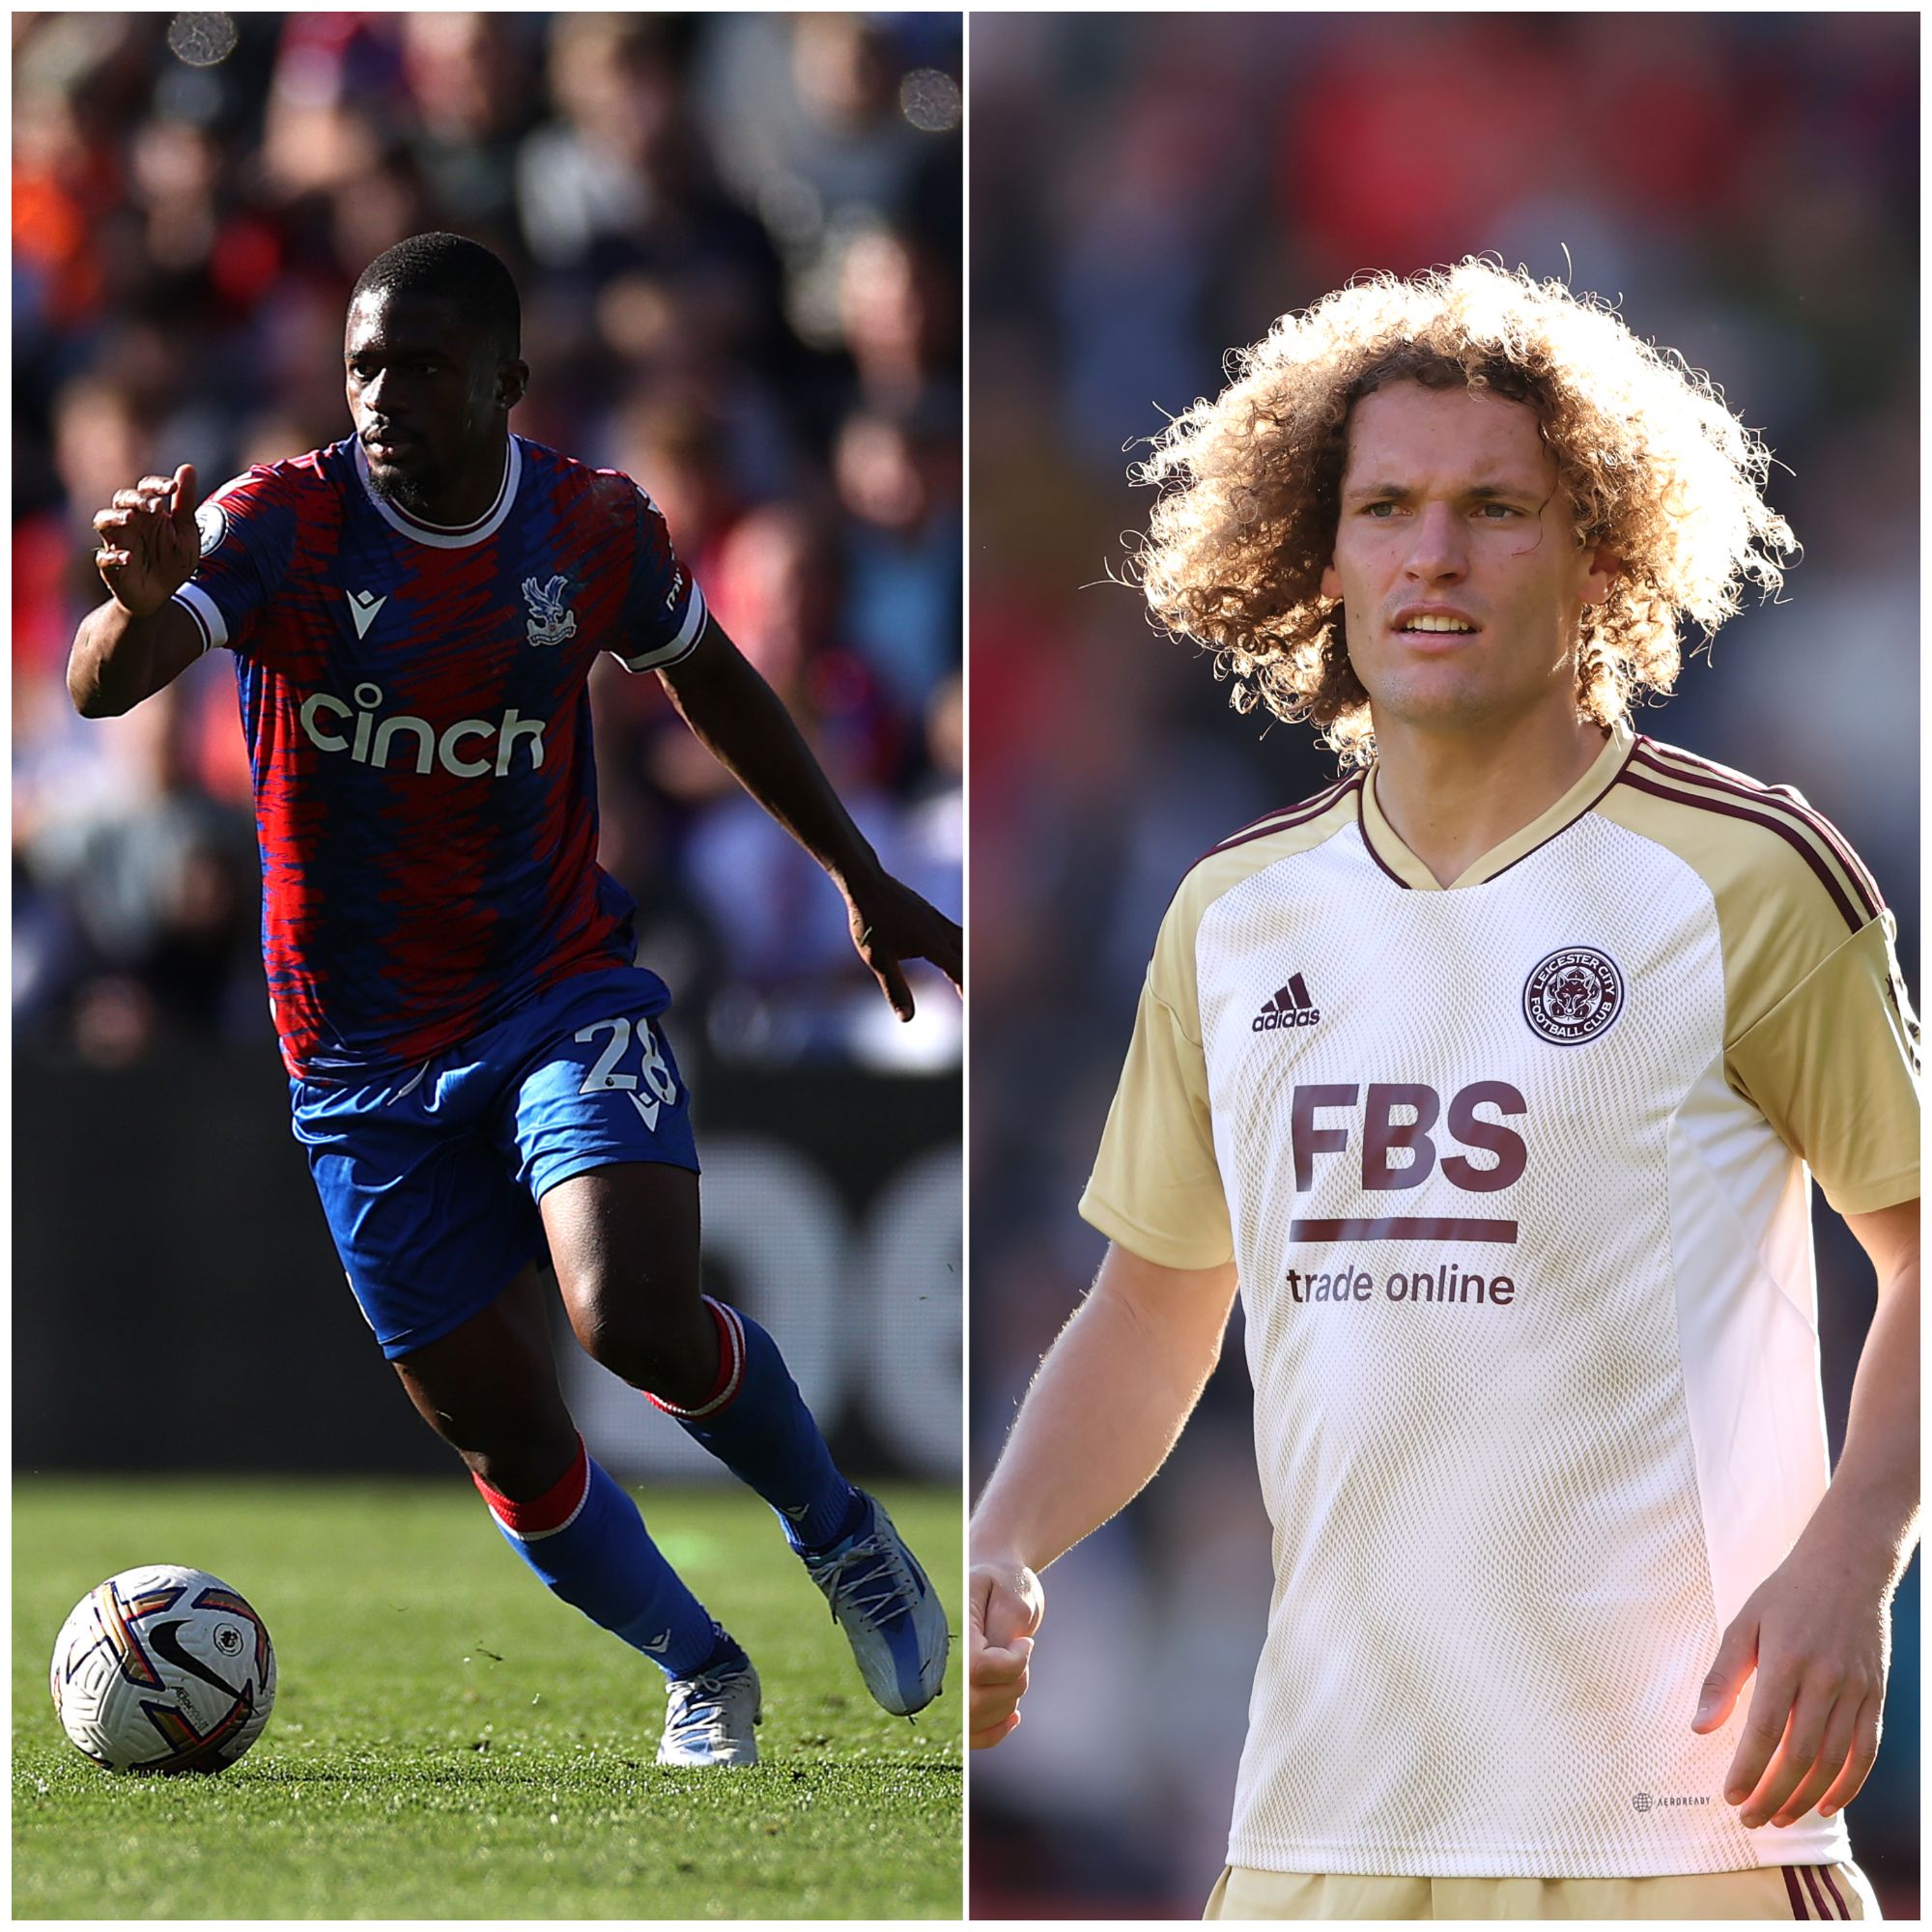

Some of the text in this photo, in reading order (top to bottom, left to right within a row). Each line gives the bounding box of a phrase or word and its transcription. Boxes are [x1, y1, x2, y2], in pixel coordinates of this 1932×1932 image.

[299, 682, 546, 778] cinch
[1533, 953, 1615, 996] LEICESTER CITY
[1252, 1008, 1321, 1033] adidas
[1531, 996, 1612, 1037] FOOTBALL CLUB
[575, 1017, 676, 1105] 28
[1291, 1080, 1528, 1193] FBS
[1286, 1264, 1516, 1305] trade online
